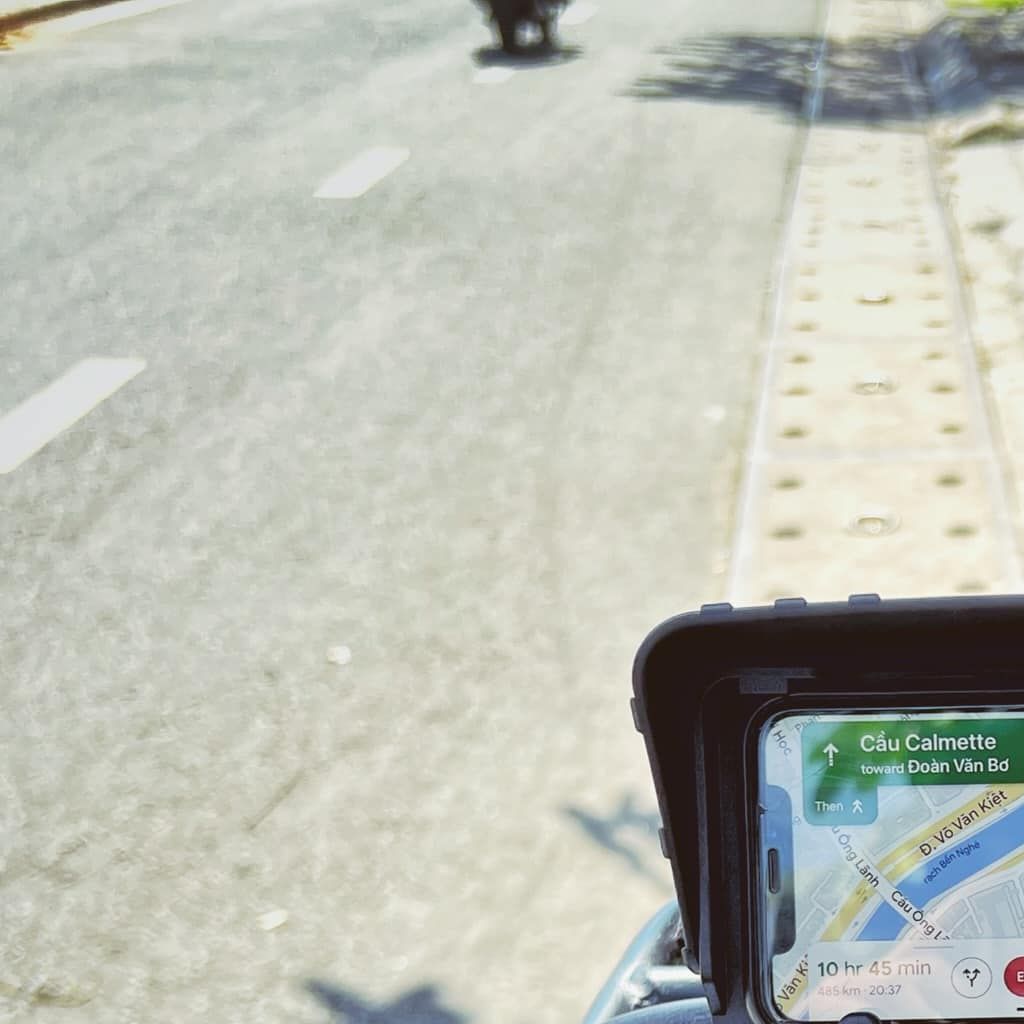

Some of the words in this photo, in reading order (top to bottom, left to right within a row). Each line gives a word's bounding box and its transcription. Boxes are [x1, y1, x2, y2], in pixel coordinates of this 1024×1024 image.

[860, 730, 900, 752] Cầu
[905, 733, 997, 751] Calmette
[861, 764, 905, 775] toward
[908, 758, 950, 774] Đoàn
[953, 758, 983, 773] Văn
[987, 757, 1009, 772] Bơ
[815, 800, 844, 812] Then
[818, 962, 839, 977] 10
[844, 961, 863, 976] hr
[868, 959, 892, 975] 45
[897, 959, 931, 976] min
[841, 985, 861, 997] km
[869, 984, 901, 997] 20:37
